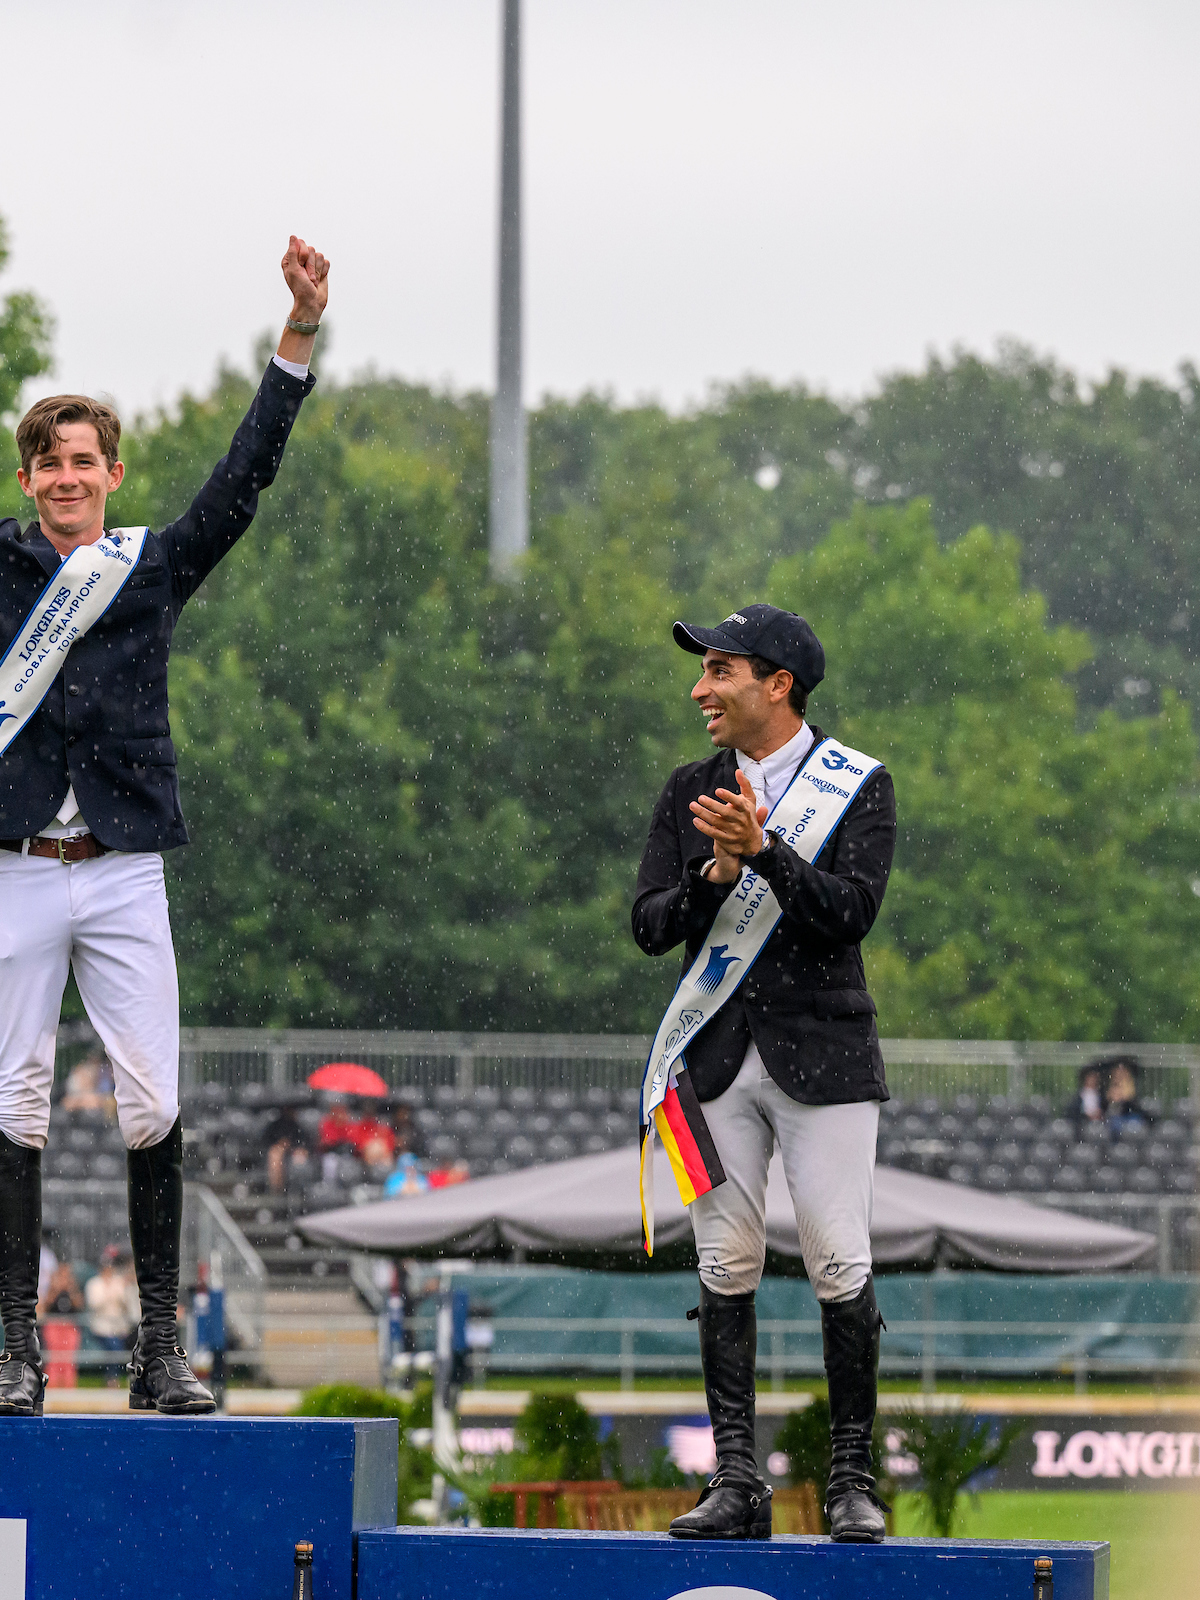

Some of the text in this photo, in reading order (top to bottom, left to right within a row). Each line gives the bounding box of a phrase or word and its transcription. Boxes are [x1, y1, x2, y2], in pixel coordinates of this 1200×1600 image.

[14, 571, 101, 692] GLOBAL CHAMPIONS
[19, 586, 71, 661] LONGINES
[57, 626, 80, 652] TOUR
[801, 772, 850, 799] LONGINES
[821, 750, 864, 776] 3RD
[735, 886, 769, 935] GLOBAL
[1031, 1430, 1200, 1478] LONGI
